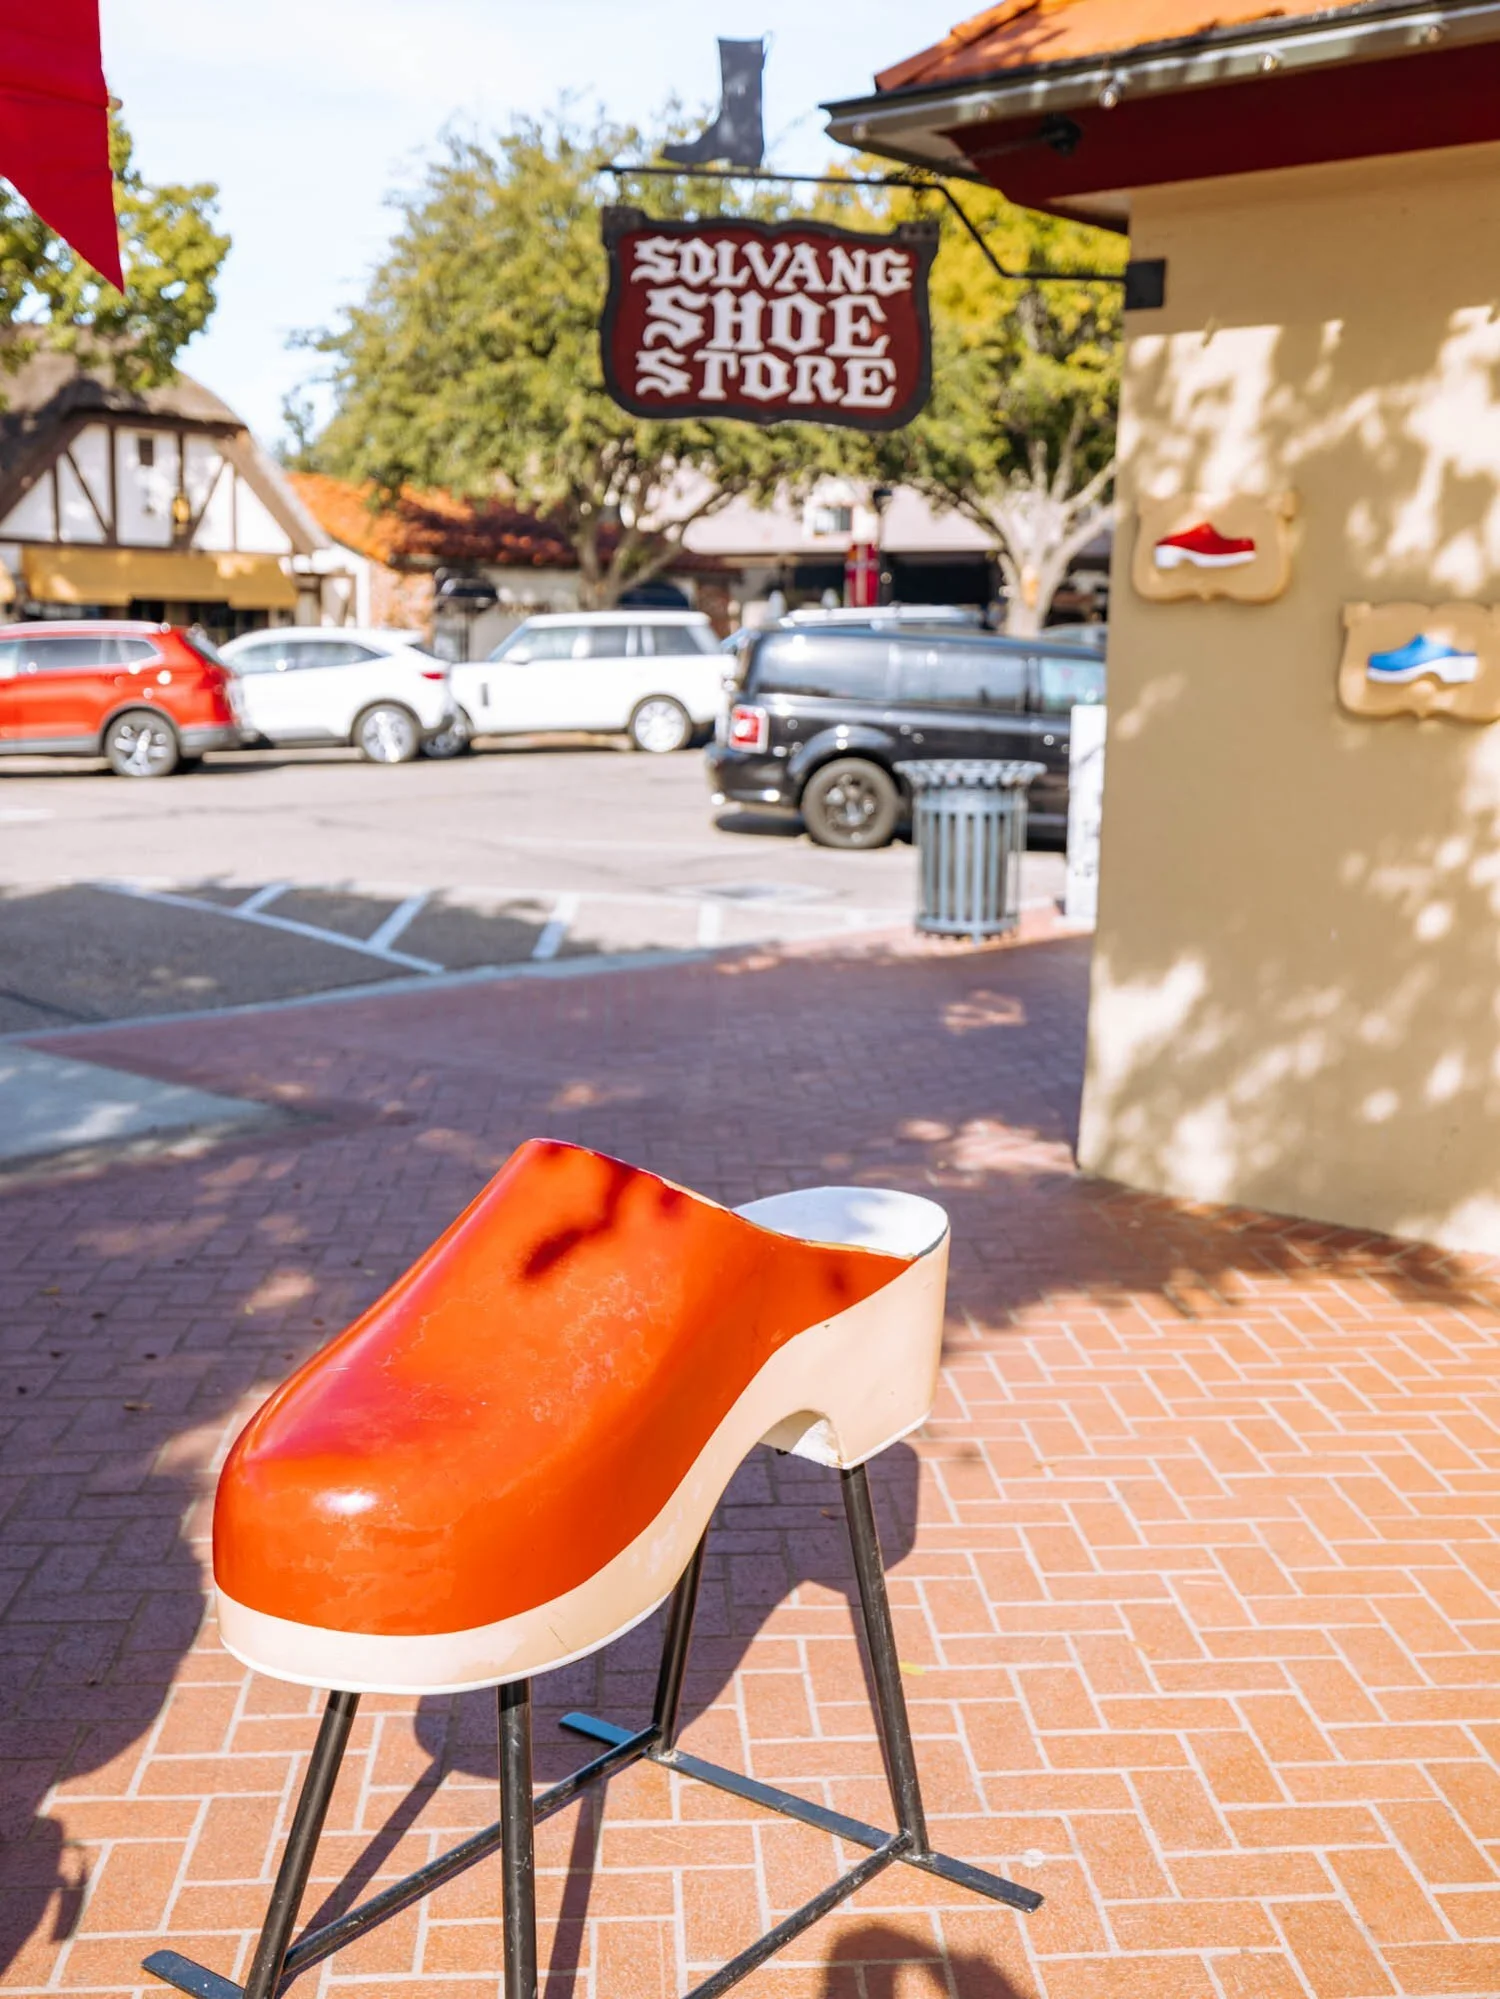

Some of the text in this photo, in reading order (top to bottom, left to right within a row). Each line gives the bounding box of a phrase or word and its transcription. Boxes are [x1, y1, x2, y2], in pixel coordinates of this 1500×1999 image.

[631, 236, 912, 296] SOLVANG
[642, 285, 890, 357] SHOE
[634, 348, 896, 409] STORE
